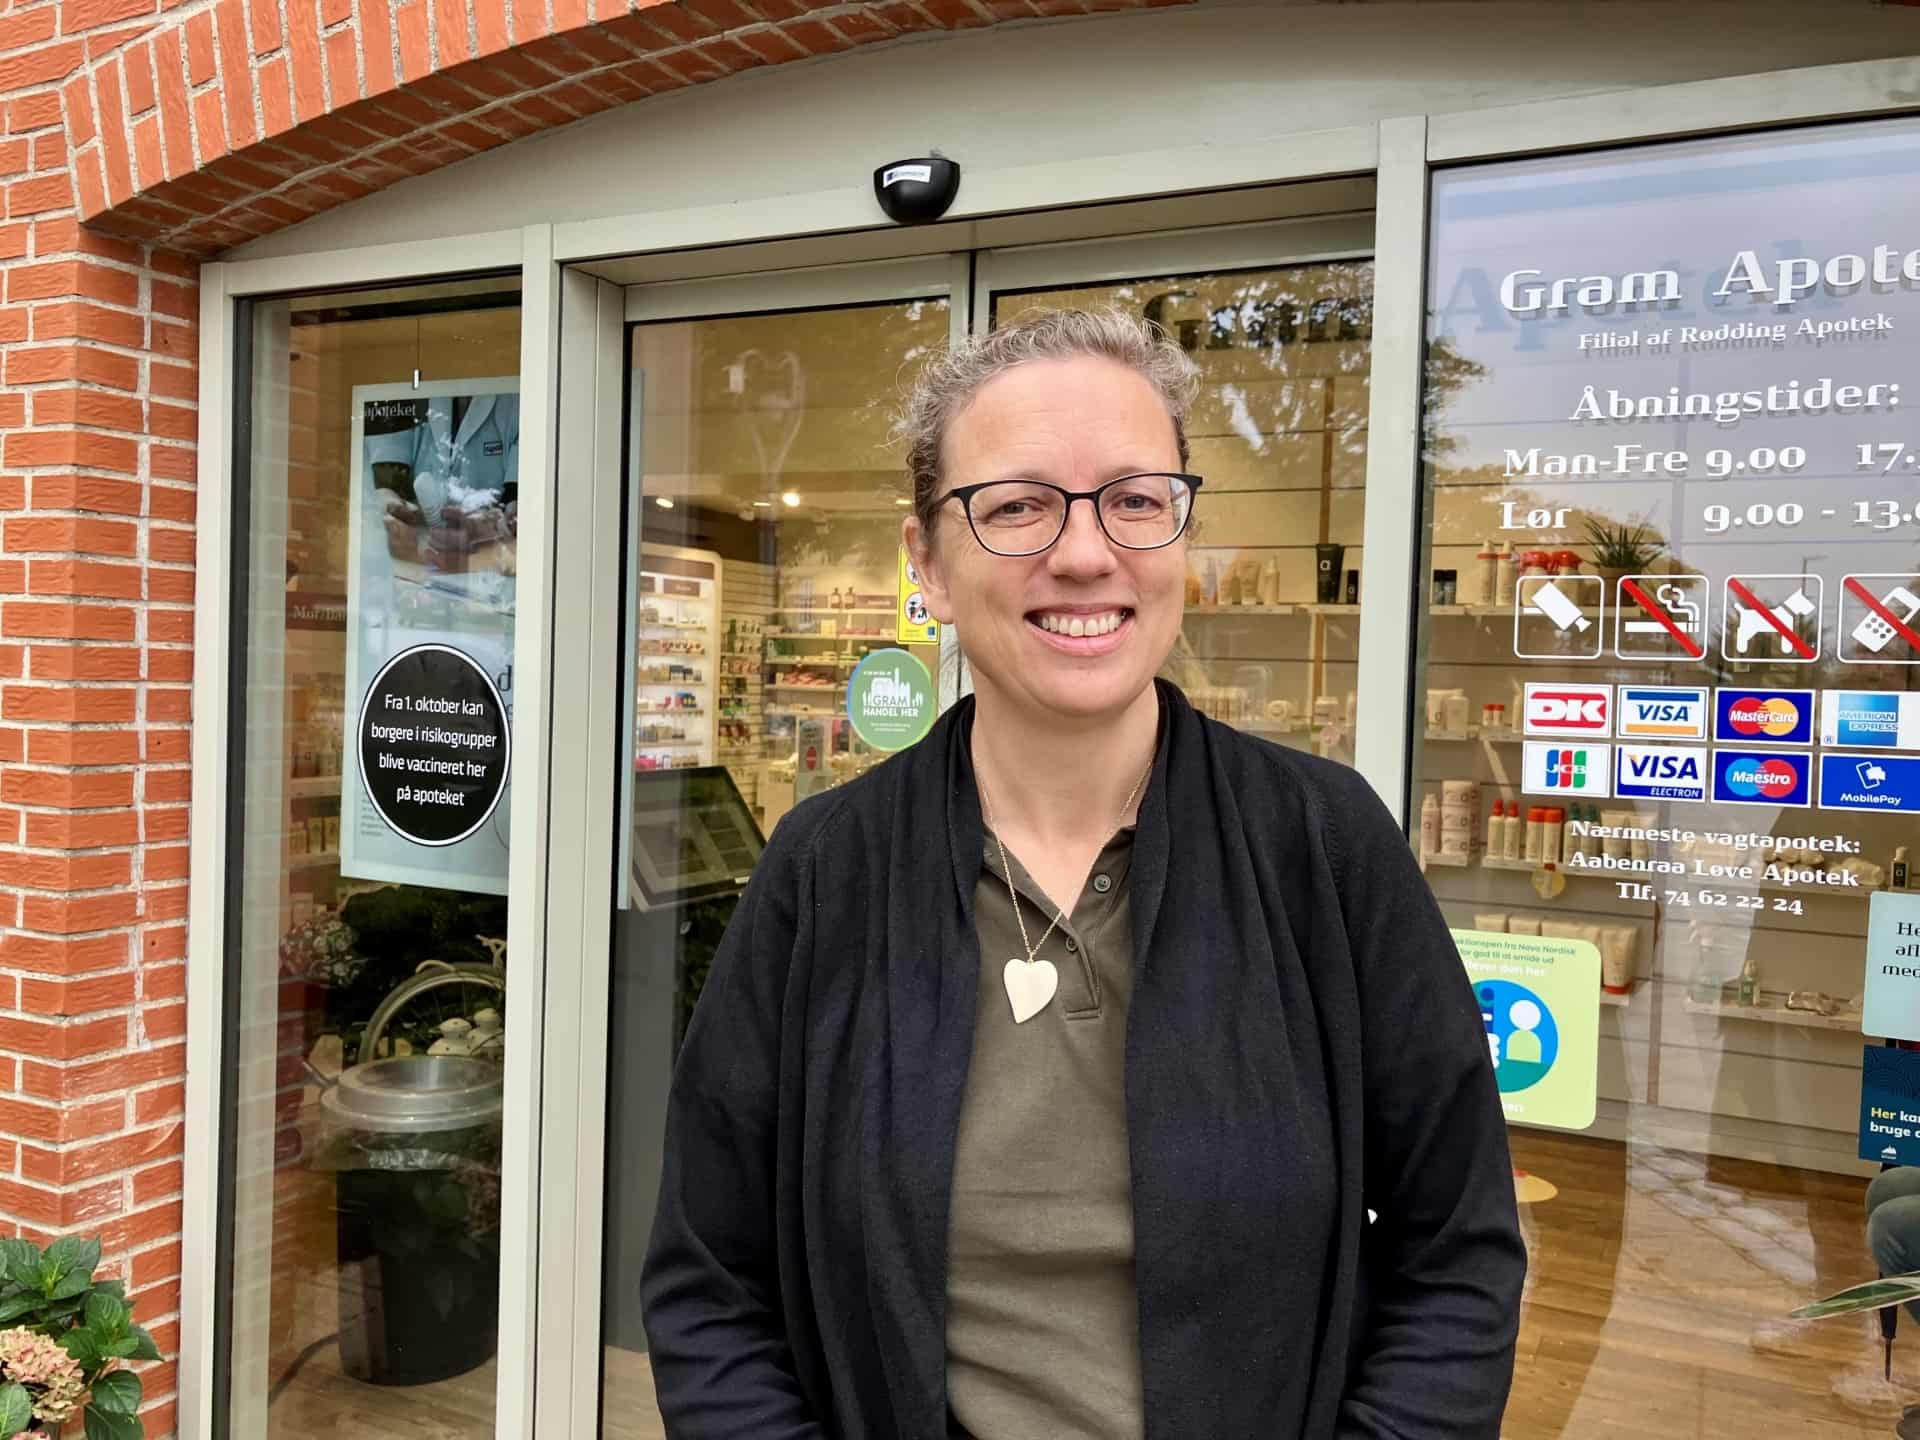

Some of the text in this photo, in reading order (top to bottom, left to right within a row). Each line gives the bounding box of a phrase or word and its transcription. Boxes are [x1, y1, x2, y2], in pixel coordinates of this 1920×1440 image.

[1500, 268, 1682, 313] Gram
[1576, 312, 1894, 351] Filial af Rødding Apotek
[1568, 378, 1900, 422] Åbningstider:
[1502, 442, 1920, 478] Man-Fre 9.00 17.
[1499, 501, 1572, 529] Lør
[1704, 501, 1804, 532] 9.00
[1853, 500, 1920, 529] 13.
[385, 693, 484, 716] Fra 1. oktober kan
[872, 694, 908, 706] GRAM
[1528, 697, 1607, 724] DK
[863, 706, 919, 718] HANDEL HER
[1637, 703, 1690, 722] VISA
[1729, 709, 1796, 724] MasterCard
[1839, 711, 1896, 721] AMERICAN
[371, 721, 414, 743] borgere
[421, 725, 497, 750] risikogrupper
[1849, 722, 1898, 732] EXPRESS
[378, 752, 487, 777] blive vaccineret her
[1629, 754, 1699, 780] VISA
[1732, 770, 1791, 786] Maestro
[396, 785, 465, 807] på apoteket
[1650, 786, 1701, 798] ELECTRON
[1839, 792, 1902, 806] MobilePay
[1570, 820, 1861, 855] Nærmeste vagtapotek:
[1568, 850, 1859, 887] Aabenraa Løve Apotek
[1615, 881, 1804, 915] Tlf. 74 62 22 24
[1518, 943, 1541, 952] Novo
[1871, 1106, 1920, 1124] Her ka
[1869, 1120, 1911, 1138] bruge
